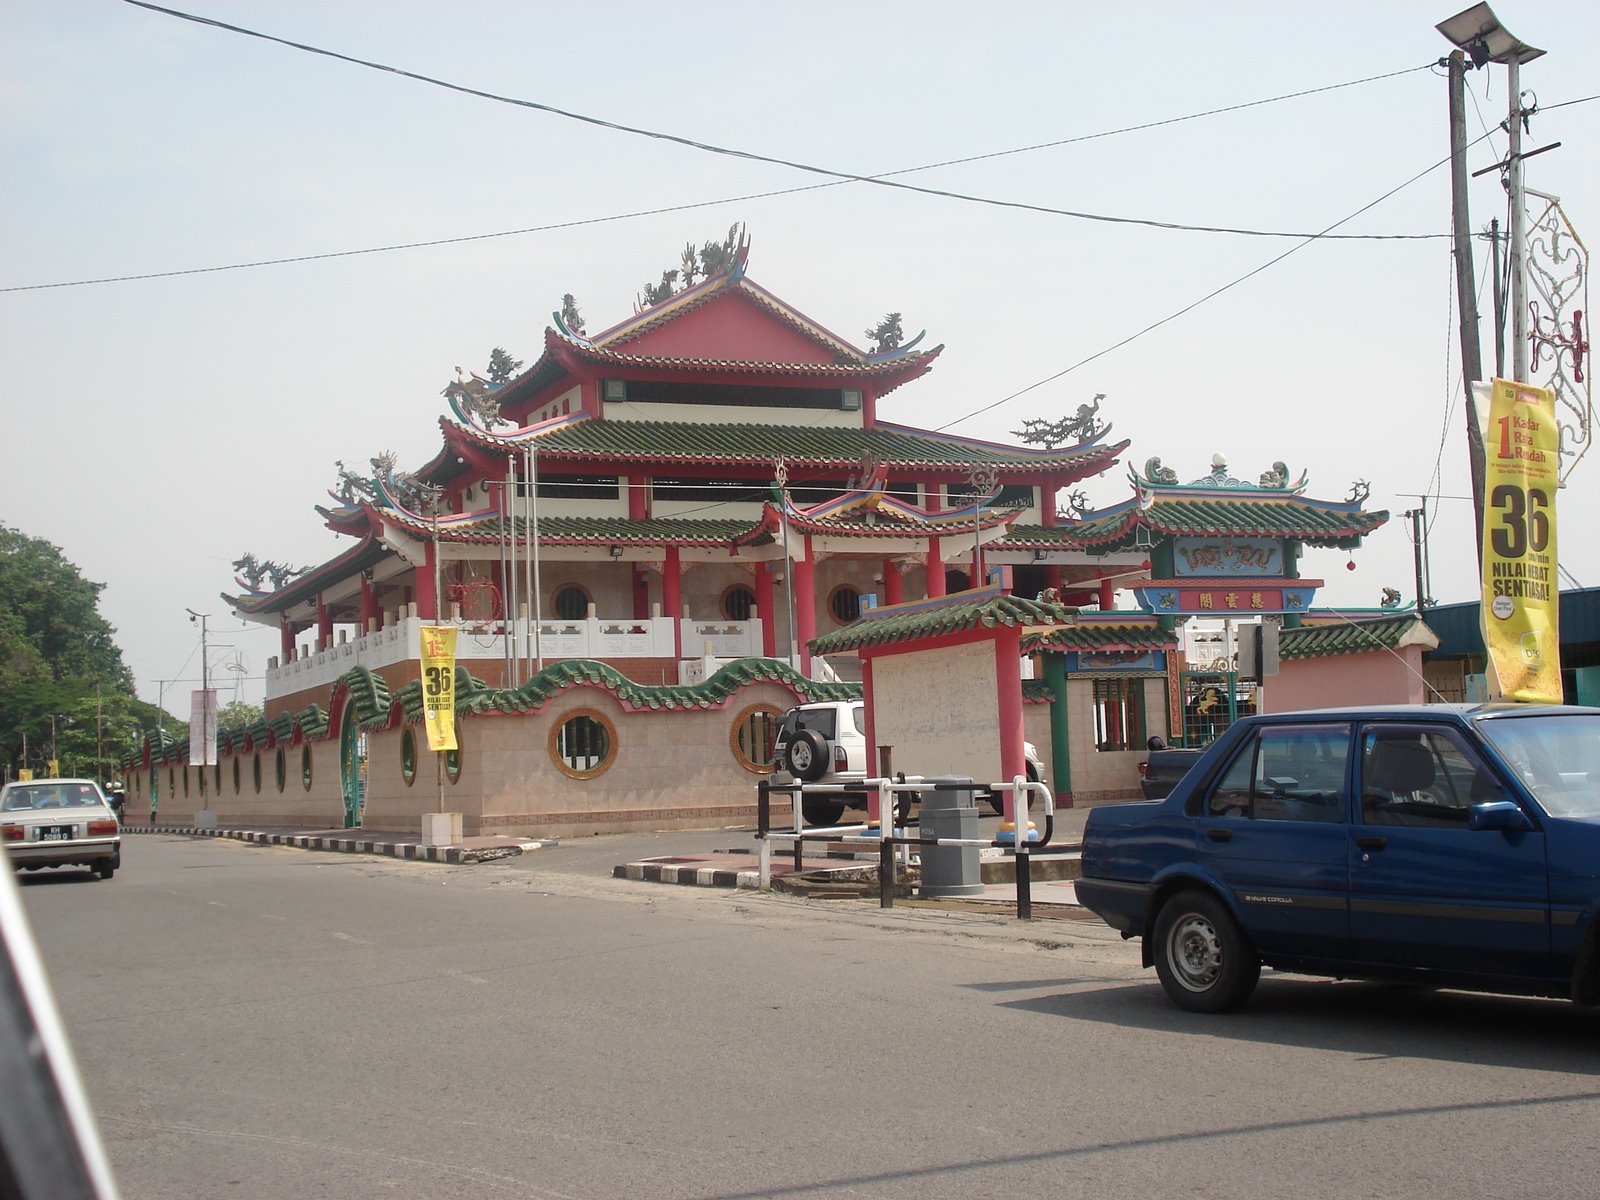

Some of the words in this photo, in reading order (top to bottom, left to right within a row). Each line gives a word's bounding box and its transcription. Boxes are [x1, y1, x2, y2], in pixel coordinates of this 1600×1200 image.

[1512, 415, 1540, 431] Kadar
[1497, 415, 1514, 459] 1
[1514, 446, 1546, 463] Rendah
[1491, 484, 1549, 558] 36
[1492, 562, 1527, 578] NILAI
[1527, 563, 1550, 582] HEBAT
[1492, 578, 1550, 602] SENTIASA!
[425, 666, 451, 696] 36
